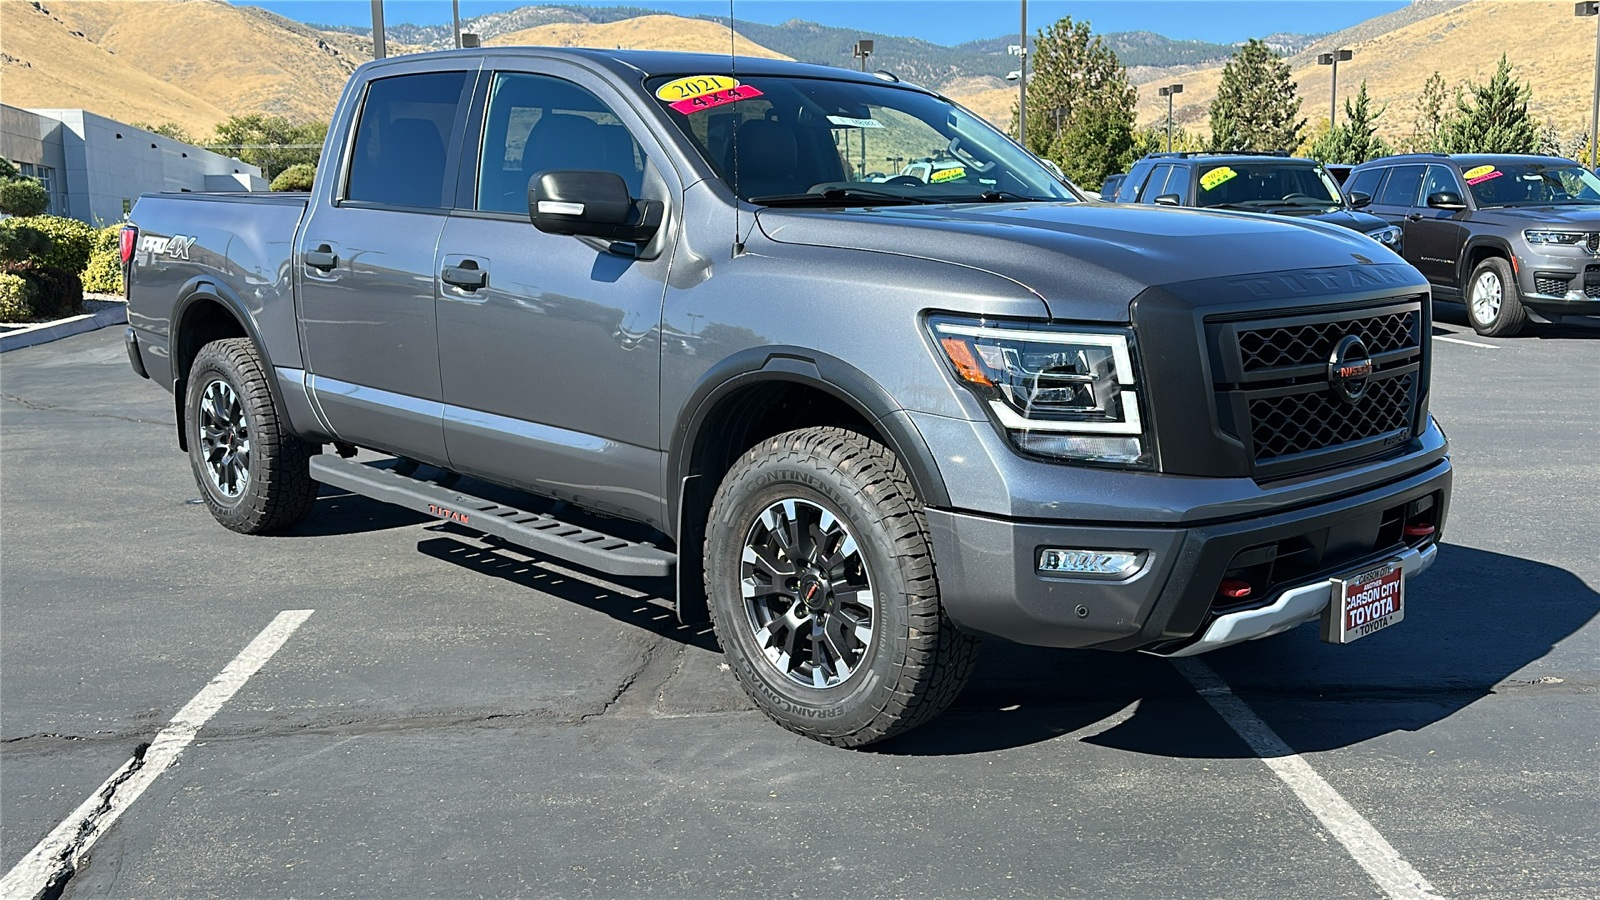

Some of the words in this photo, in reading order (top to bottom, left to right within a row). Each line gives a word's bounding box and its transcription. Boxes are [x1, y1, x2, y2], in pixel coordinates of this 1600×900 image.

[672, 77, 724, 98] 2021
[1227, 267, 1408, 296] TITAN
[1340, 363, 1373, 378] NISSAN
[745, 469, 860, 523] CONTINENTAL
[428, 503, 469, 524] TITAN
[1359, 570, 1380, 584] CARSON
[1380, 565, 1393, 577] CITY
[1363, 579, 1382, 591] ANOTHER
[1381, 579, 1400, 597] CITY
[1349, 596, 1394, 627] TOYOTA
[1359, 616, 1388, 636] TOYOTA
